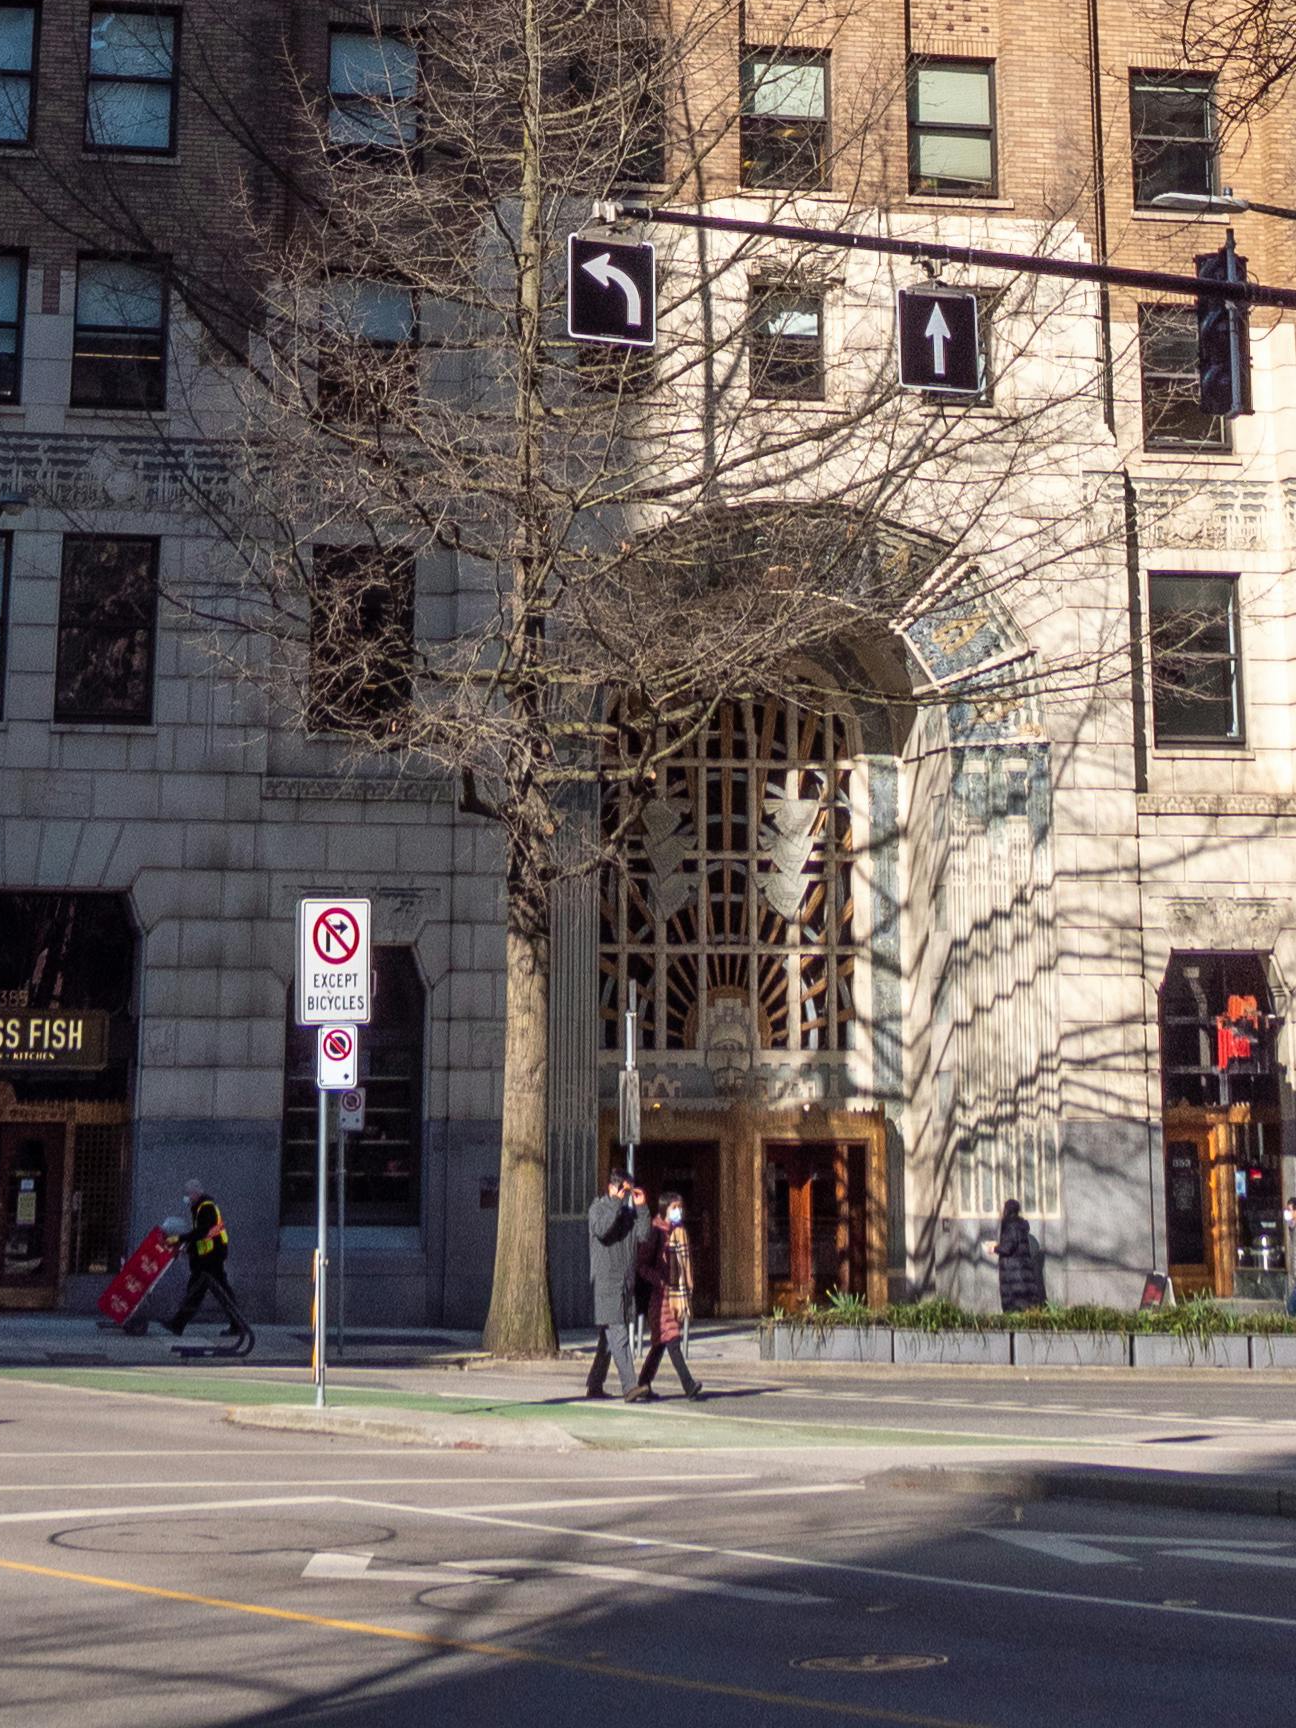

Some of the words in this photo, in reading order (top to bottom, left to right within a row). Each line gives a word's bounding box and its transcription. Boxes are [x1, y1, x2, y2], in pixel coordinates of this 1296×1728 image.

[313, 973, 358, 989] EXCEPT
[307, 995, 365, 1011] BICYCLES
[29, 1018, 83, 1050] FISH
[12, 1051, 55, 1060] KITCHEN
